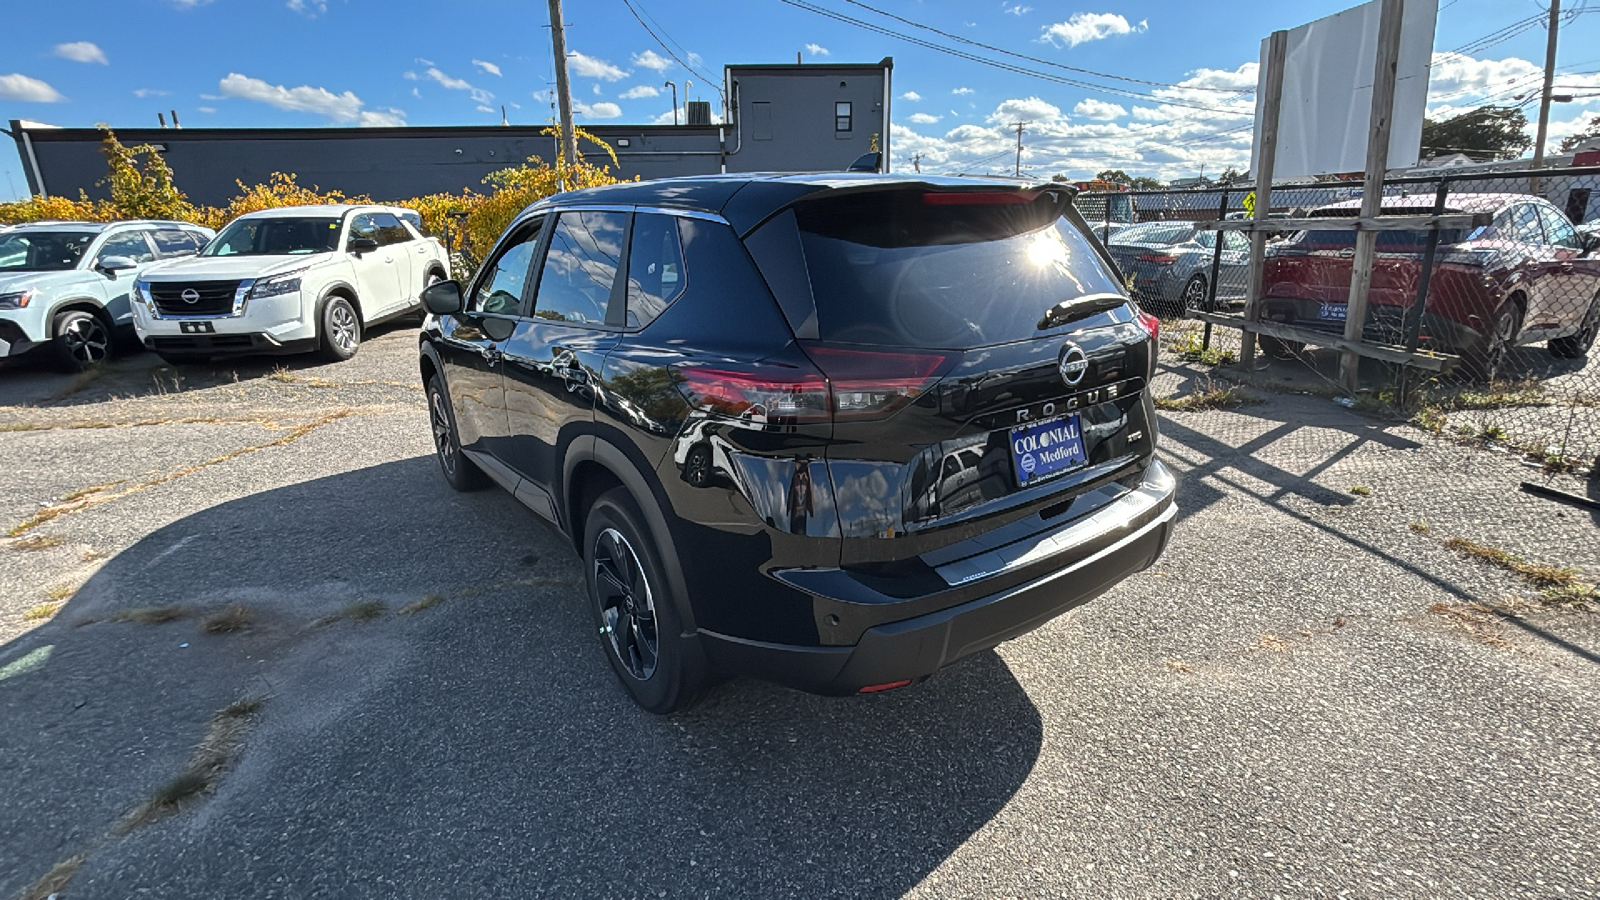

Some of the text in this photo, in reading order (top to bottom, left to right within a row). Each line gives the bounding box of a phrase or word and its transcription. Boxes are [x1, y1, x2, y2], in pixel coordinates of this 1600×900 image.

[1016, 385, 1118, 422] ROGUE
[1014, 425, 1079, 454] COLONIAL
[1039, 443, 1079, 465] Medford
